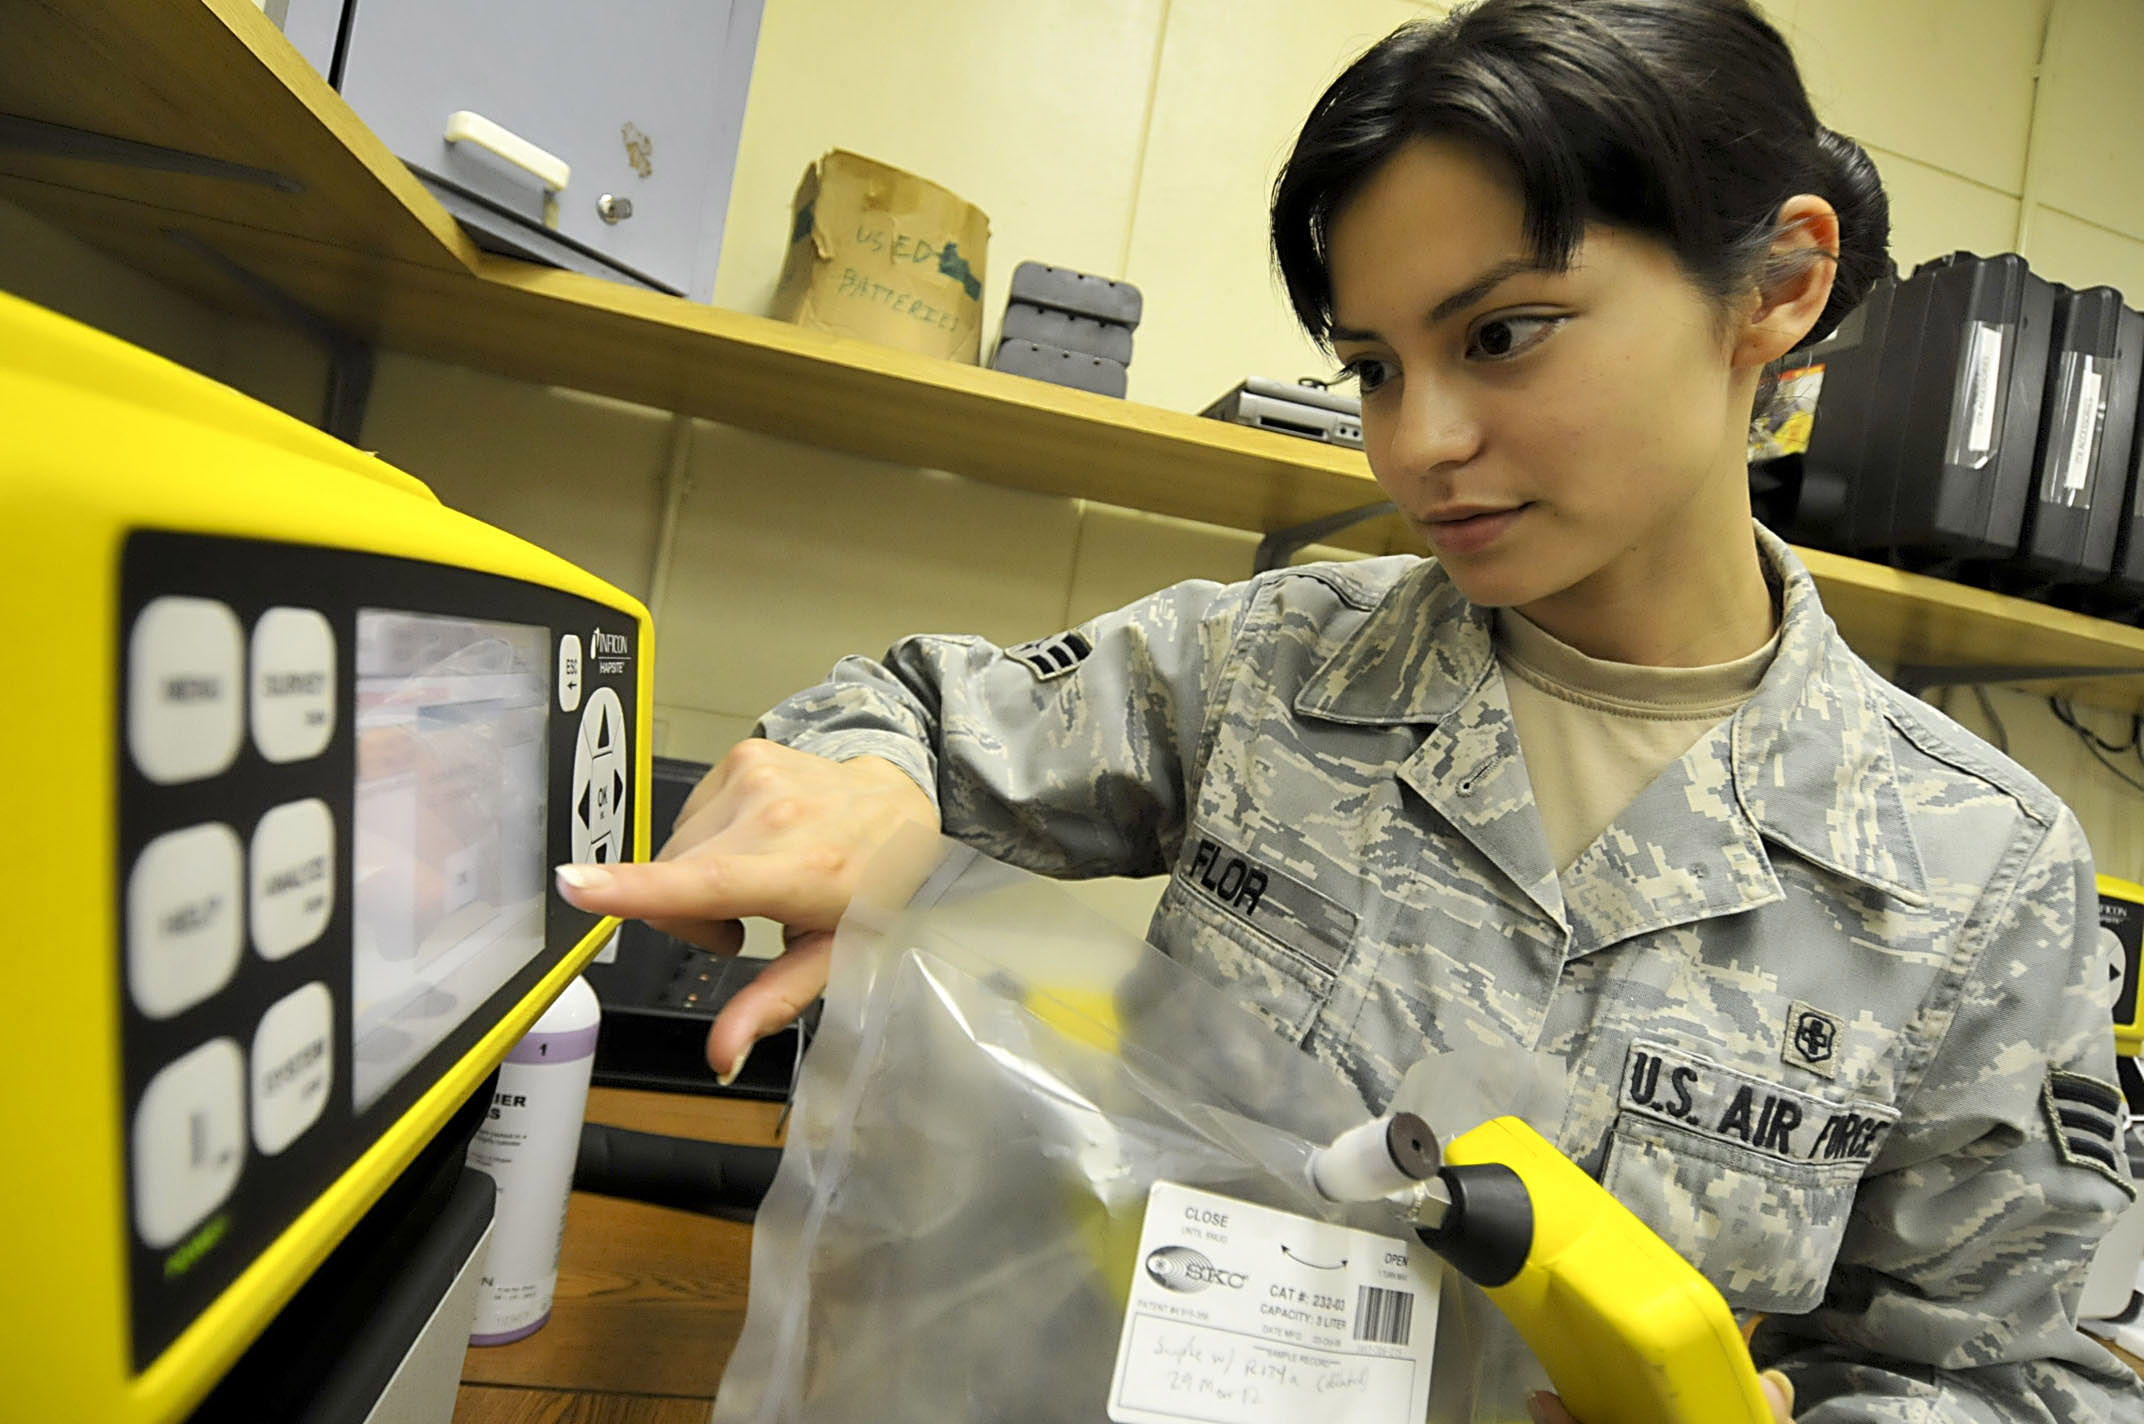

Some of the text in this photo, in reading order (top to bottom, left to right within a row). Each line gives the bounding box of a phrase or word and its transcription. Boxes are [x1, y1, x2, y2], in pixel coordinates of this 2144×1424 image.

[856, 226, 934, 263] USED
[566, 658, 577, 675] ESC
[597, 785, 608, 807] OK
[1189, 838, 1269, 916] FLOR
[539, 1043, 548, 1057] 1
[494, 1093, 527, 1108] IER
[1629, 1051, 1892, 1159] U.S. AIR FORCE
[1185, 1206, 1230, 1228] CLOSE
[1384, 1252, 1409, 1267] OPEN
[1186, 1262, 1249, 1290] SKC
[1270, 1284, 1294, 1300] CAT
[1260, 1303, 1315, 1324] CAPACITY:
